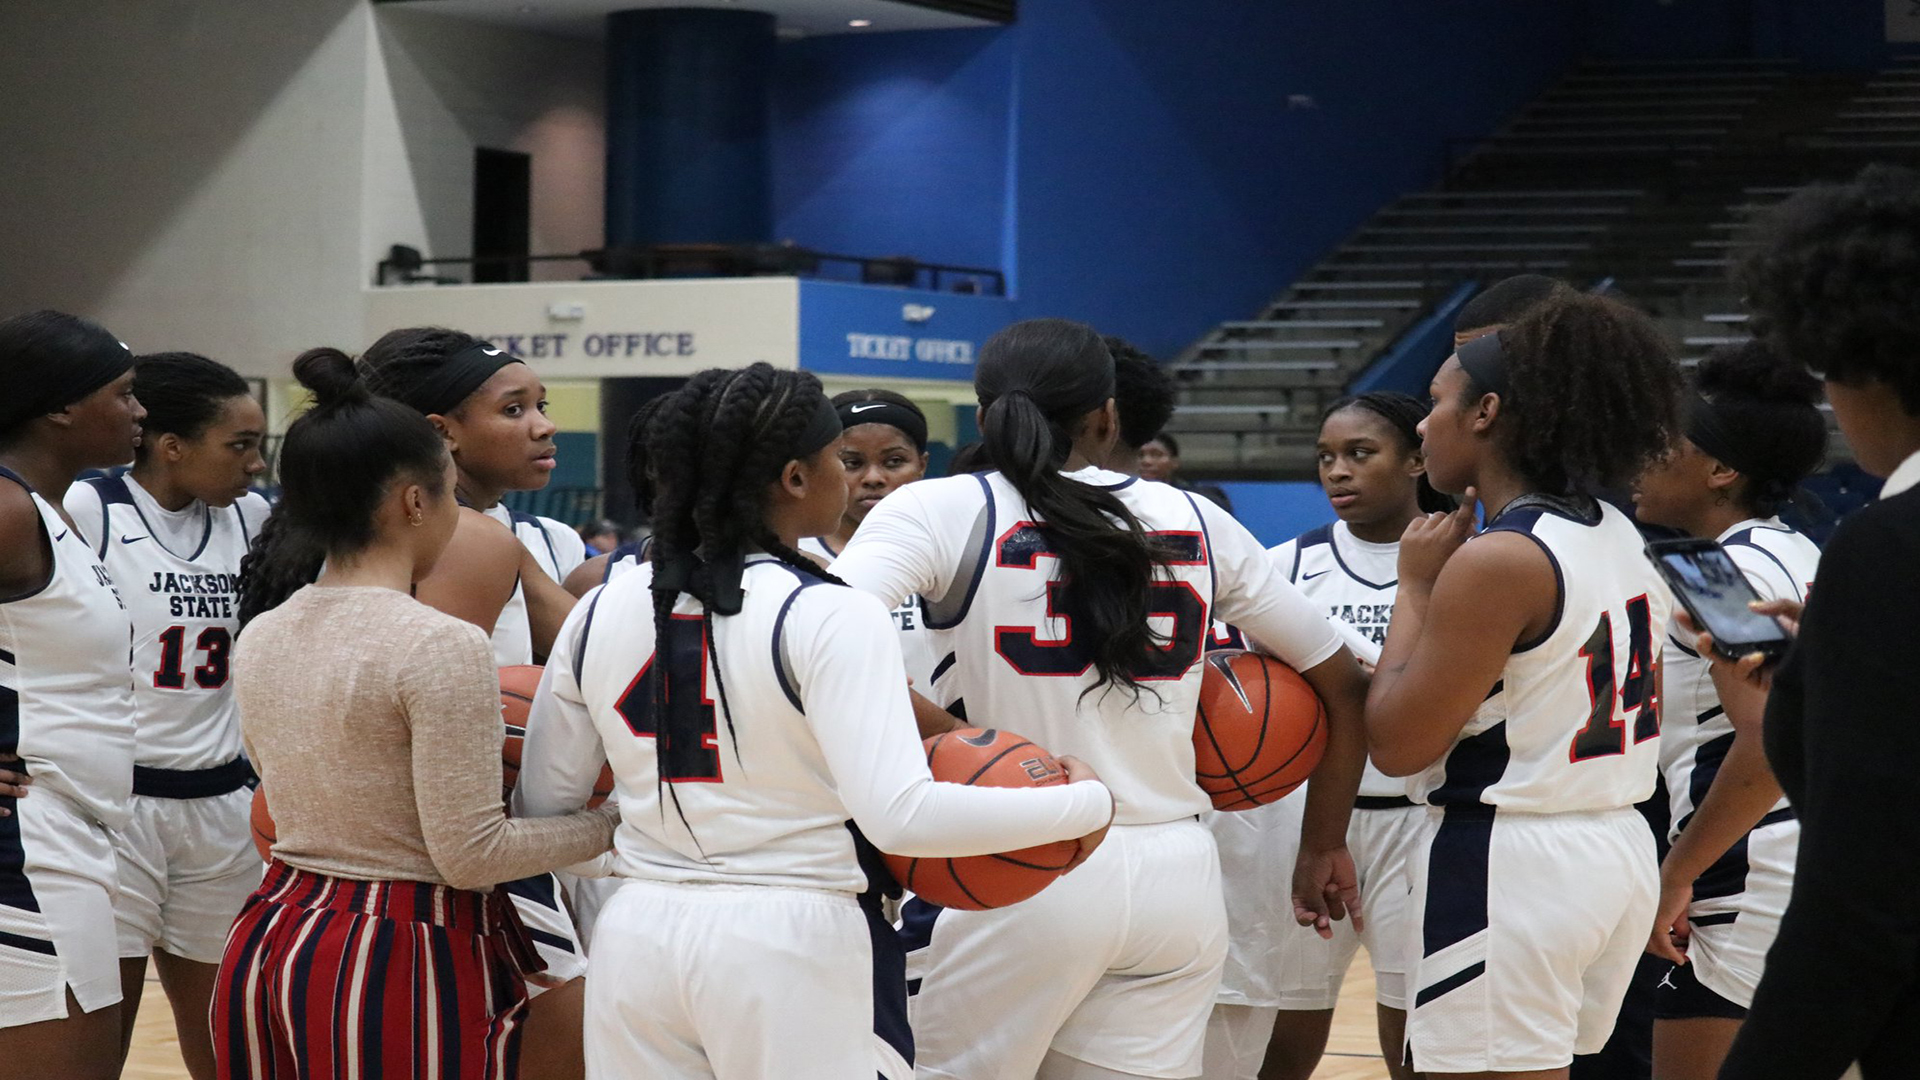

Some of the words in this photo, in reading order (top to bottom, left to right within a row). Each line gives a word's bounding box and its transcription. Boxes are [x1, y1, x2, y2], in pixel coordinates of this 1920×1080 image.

[583, 333, 696, 357] OFFICE
[846, 333, 911, 361] TICKET
[169, 595, 232, 618] STATE
[994, 520, 1207, 681] 35
[153, 625, 231, 690] 13
[1569, 593, 1660, 764] 14
[613, 613, 724, 783] 4
